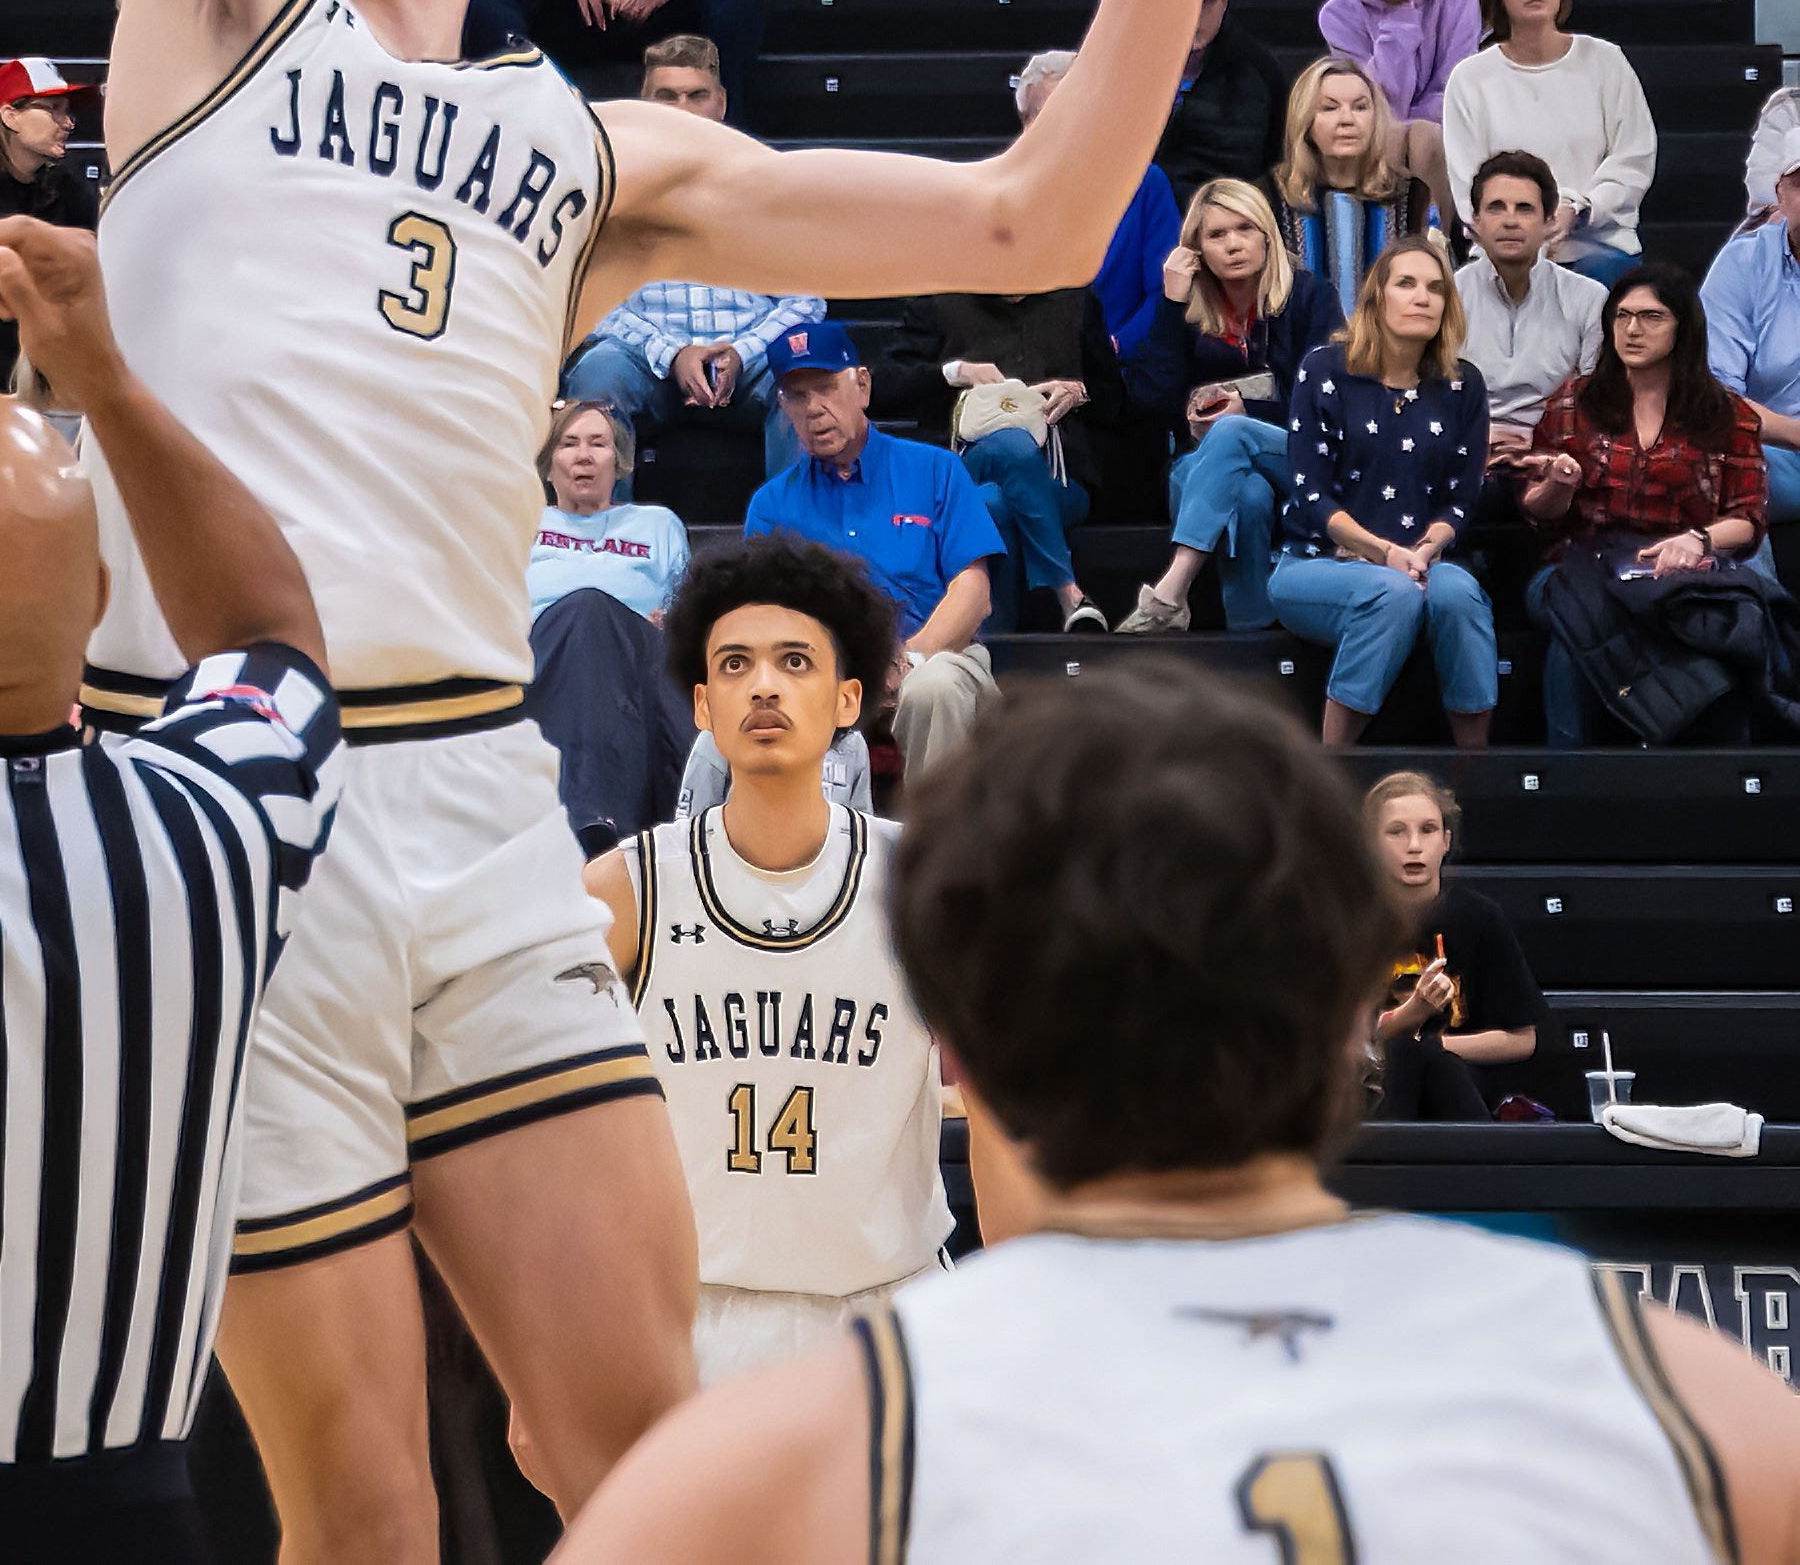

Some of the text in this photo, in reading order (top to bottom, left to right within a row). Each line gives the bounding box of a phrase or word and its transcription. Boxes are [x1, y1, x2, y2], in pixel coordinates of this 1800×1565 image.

[269, 68, 588, 269] JAGUARS
[376, 210, 457, 342] 3
[663, 991, 889, 1068] JAGUARS
[727, 1083, 819, 1175] 14
